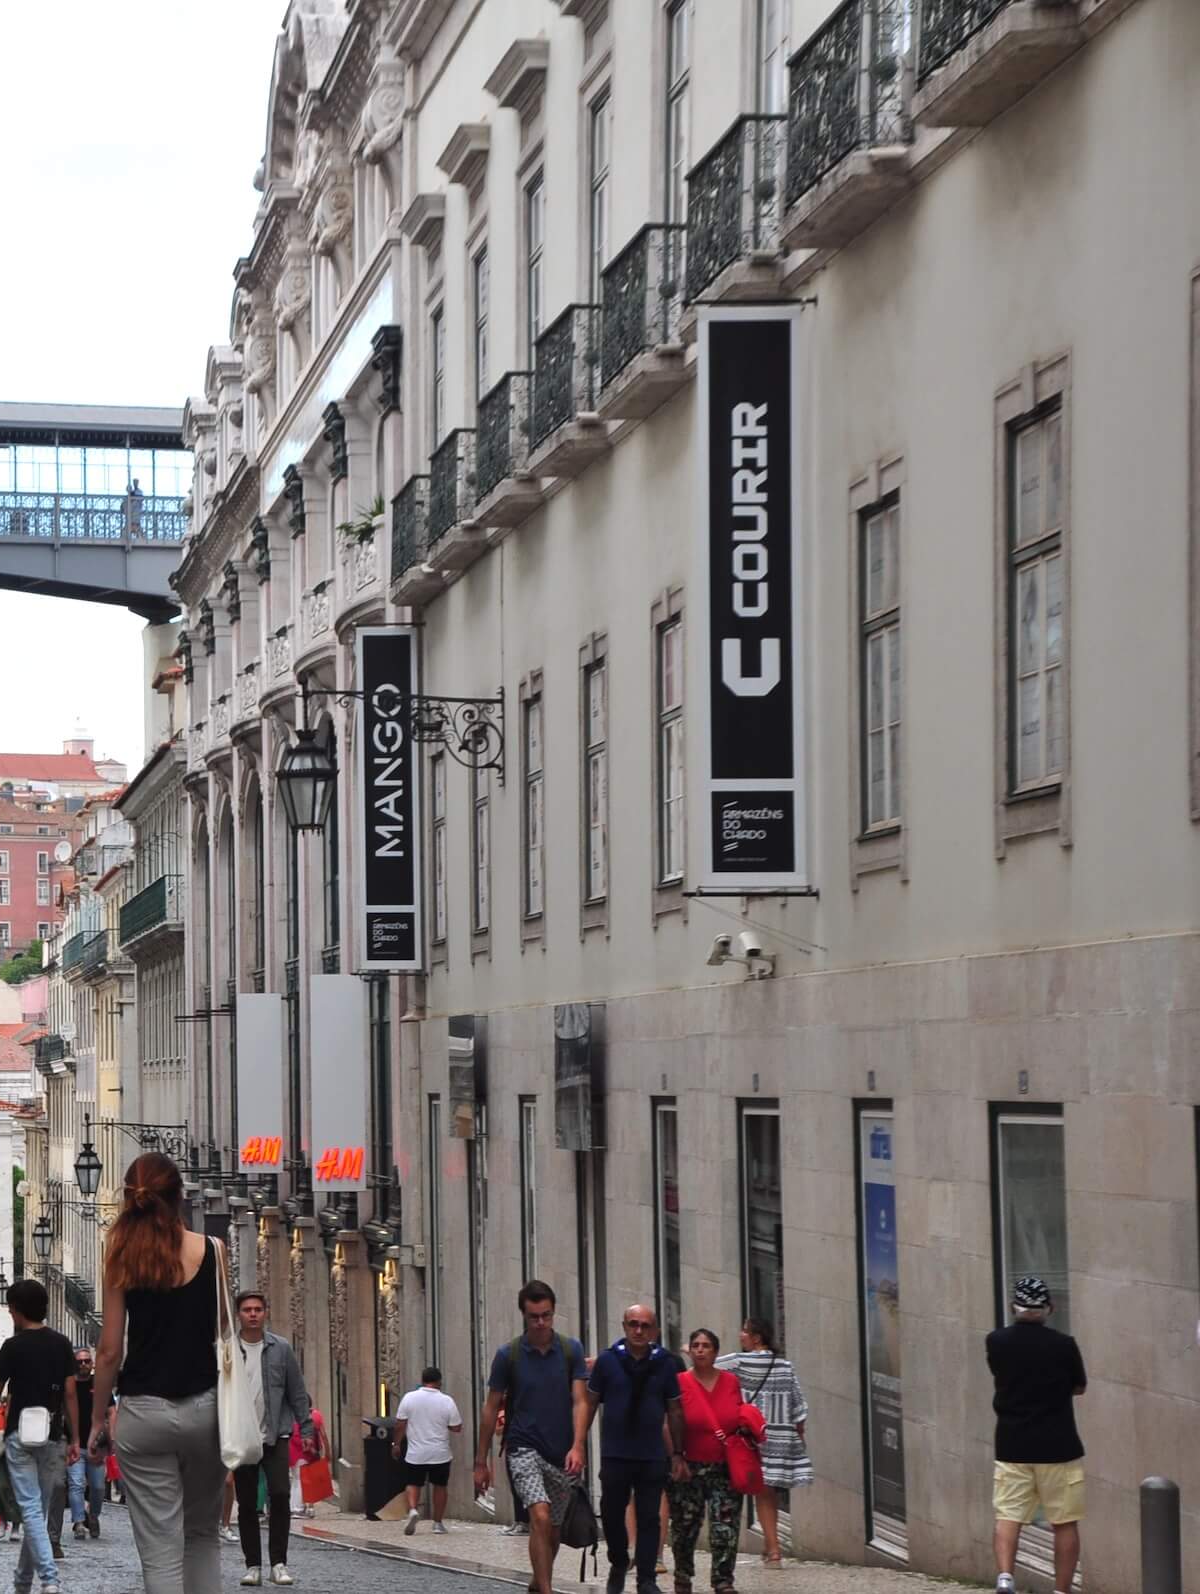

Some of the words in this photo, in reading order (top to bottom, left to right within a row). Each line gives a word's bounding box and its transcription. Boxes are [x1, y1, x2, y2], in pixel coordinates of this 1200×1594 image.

[731, 401, 770, 619] COURIR
[371, 683, 405, 858] MANGO
[723, 820, 741, 829] DO
